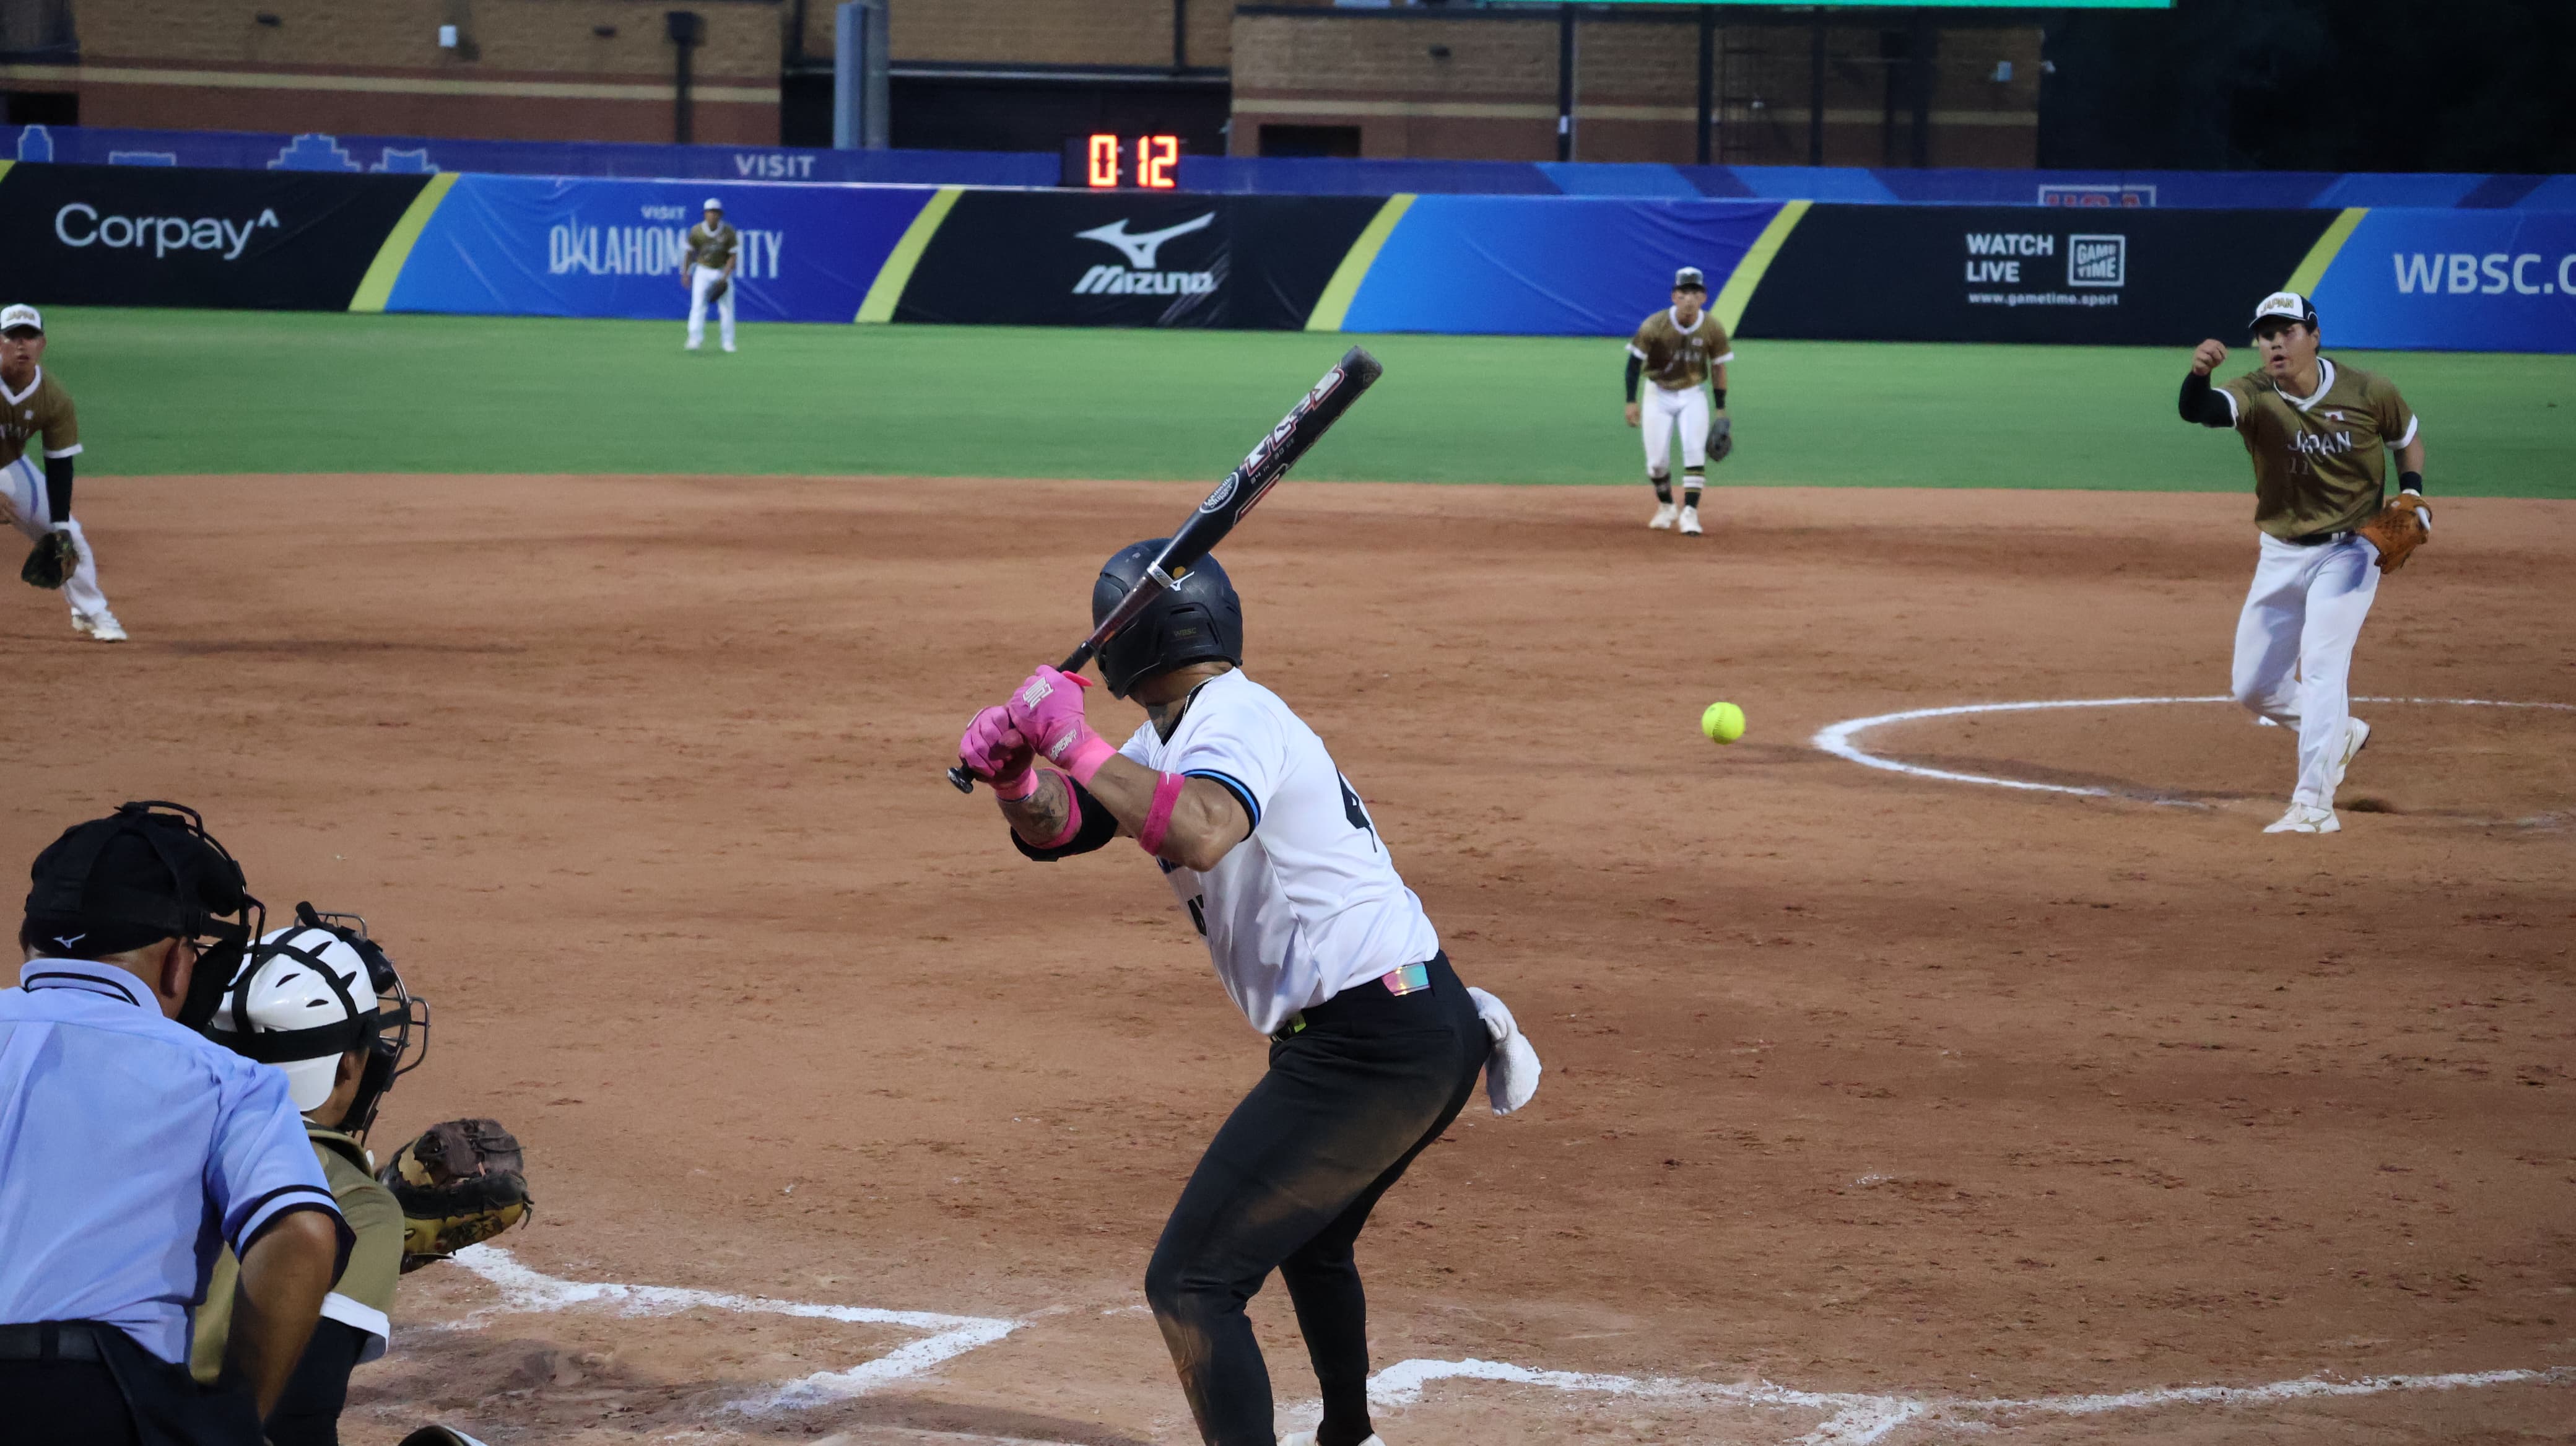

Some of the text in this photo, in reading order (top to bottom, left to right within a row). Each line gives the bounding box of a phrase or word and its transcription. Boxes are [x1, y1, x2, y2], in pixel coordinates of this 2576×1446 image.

[733, 154, 816, 177] VISIT
[640, 206, 686, 219] VISIT
[550, 214, 689, 276] OKLAHOM
[736, 229, 783, 278] ITY
[1966, 233, 2054, 256] WATCH
[2077, 243, 2116, 265] GAME
[1967, 261, 2021, 282] LIVE
[2077, 256, 2116, 278] TIME
[1969, 292, 2119, 307] www.gametime.sport
[2260, 297, 2294, 313] JAPAN
